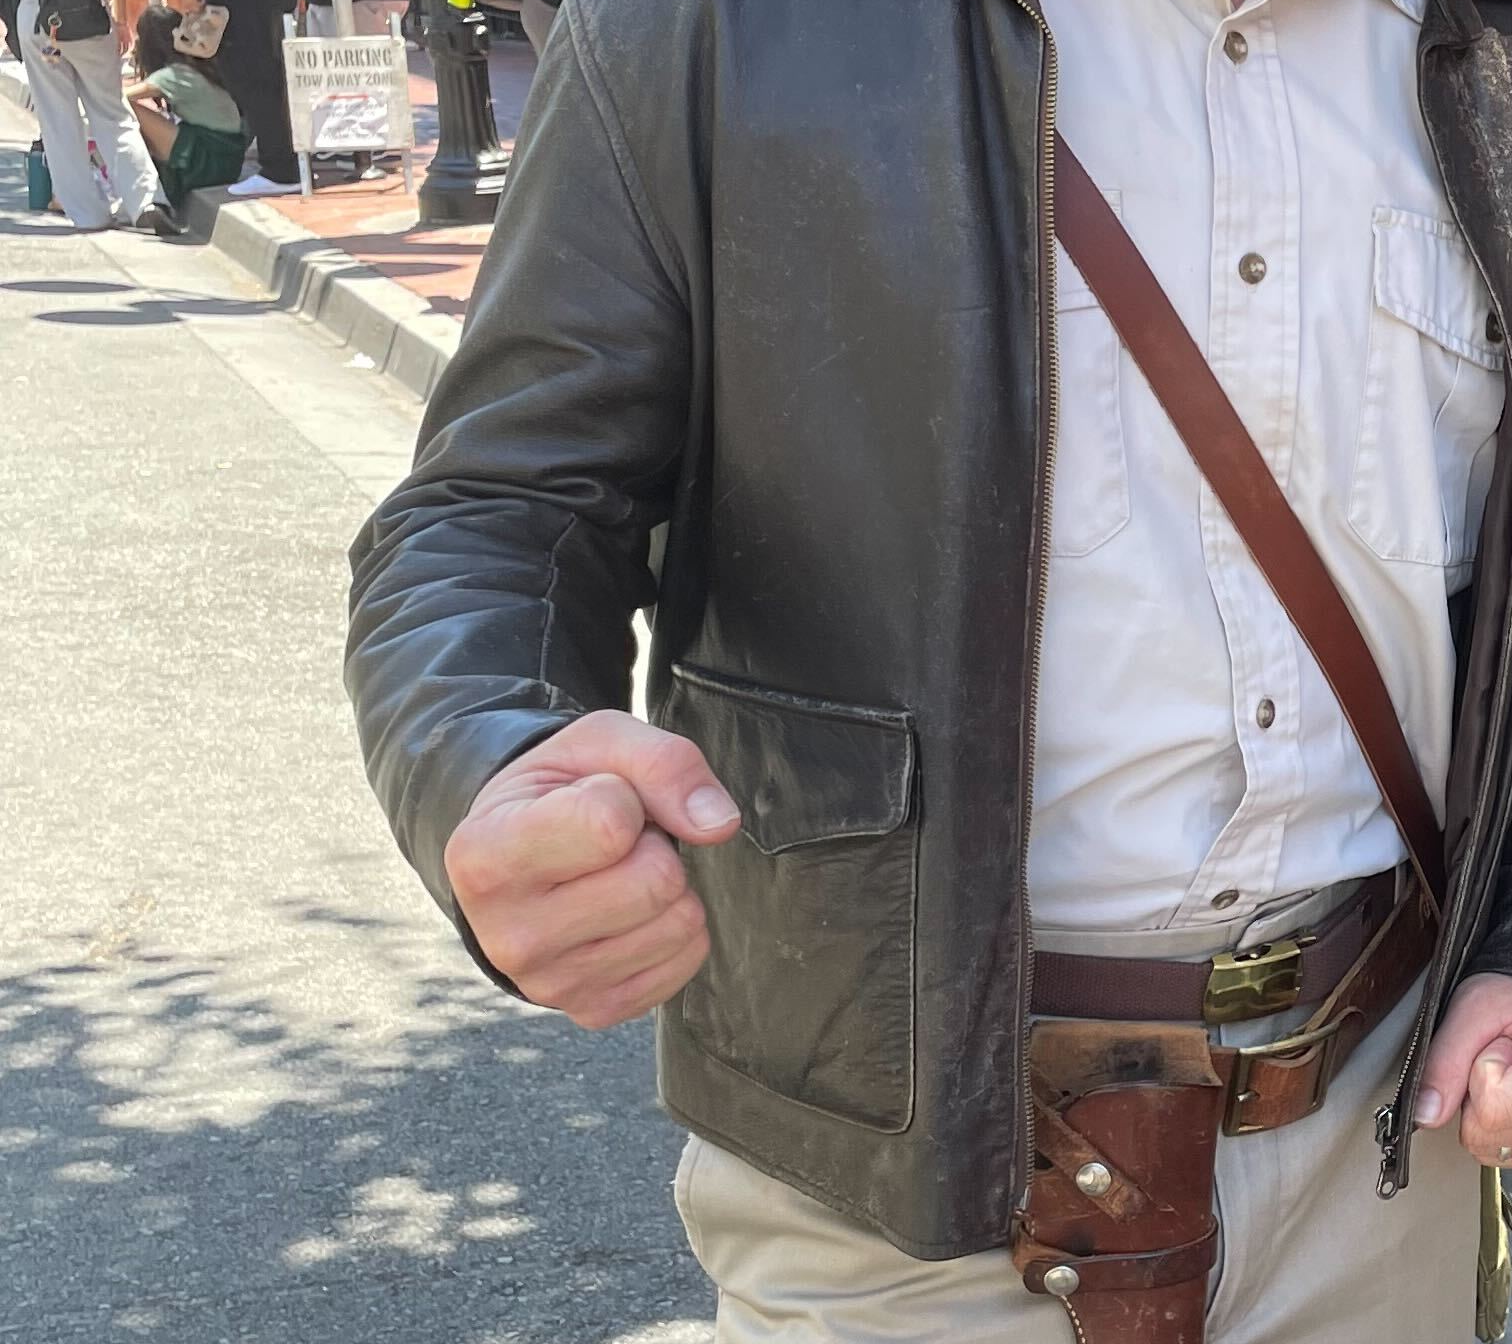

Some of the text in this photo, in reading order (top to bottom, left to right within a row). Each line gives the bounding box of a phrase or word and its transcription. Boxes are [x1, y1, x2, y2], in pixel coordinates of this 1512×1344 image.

[295, 47, 393, 68] NO PARKING
[295, 74, 323, 89] TOW
[327, 73, 361, 88] AWAY
